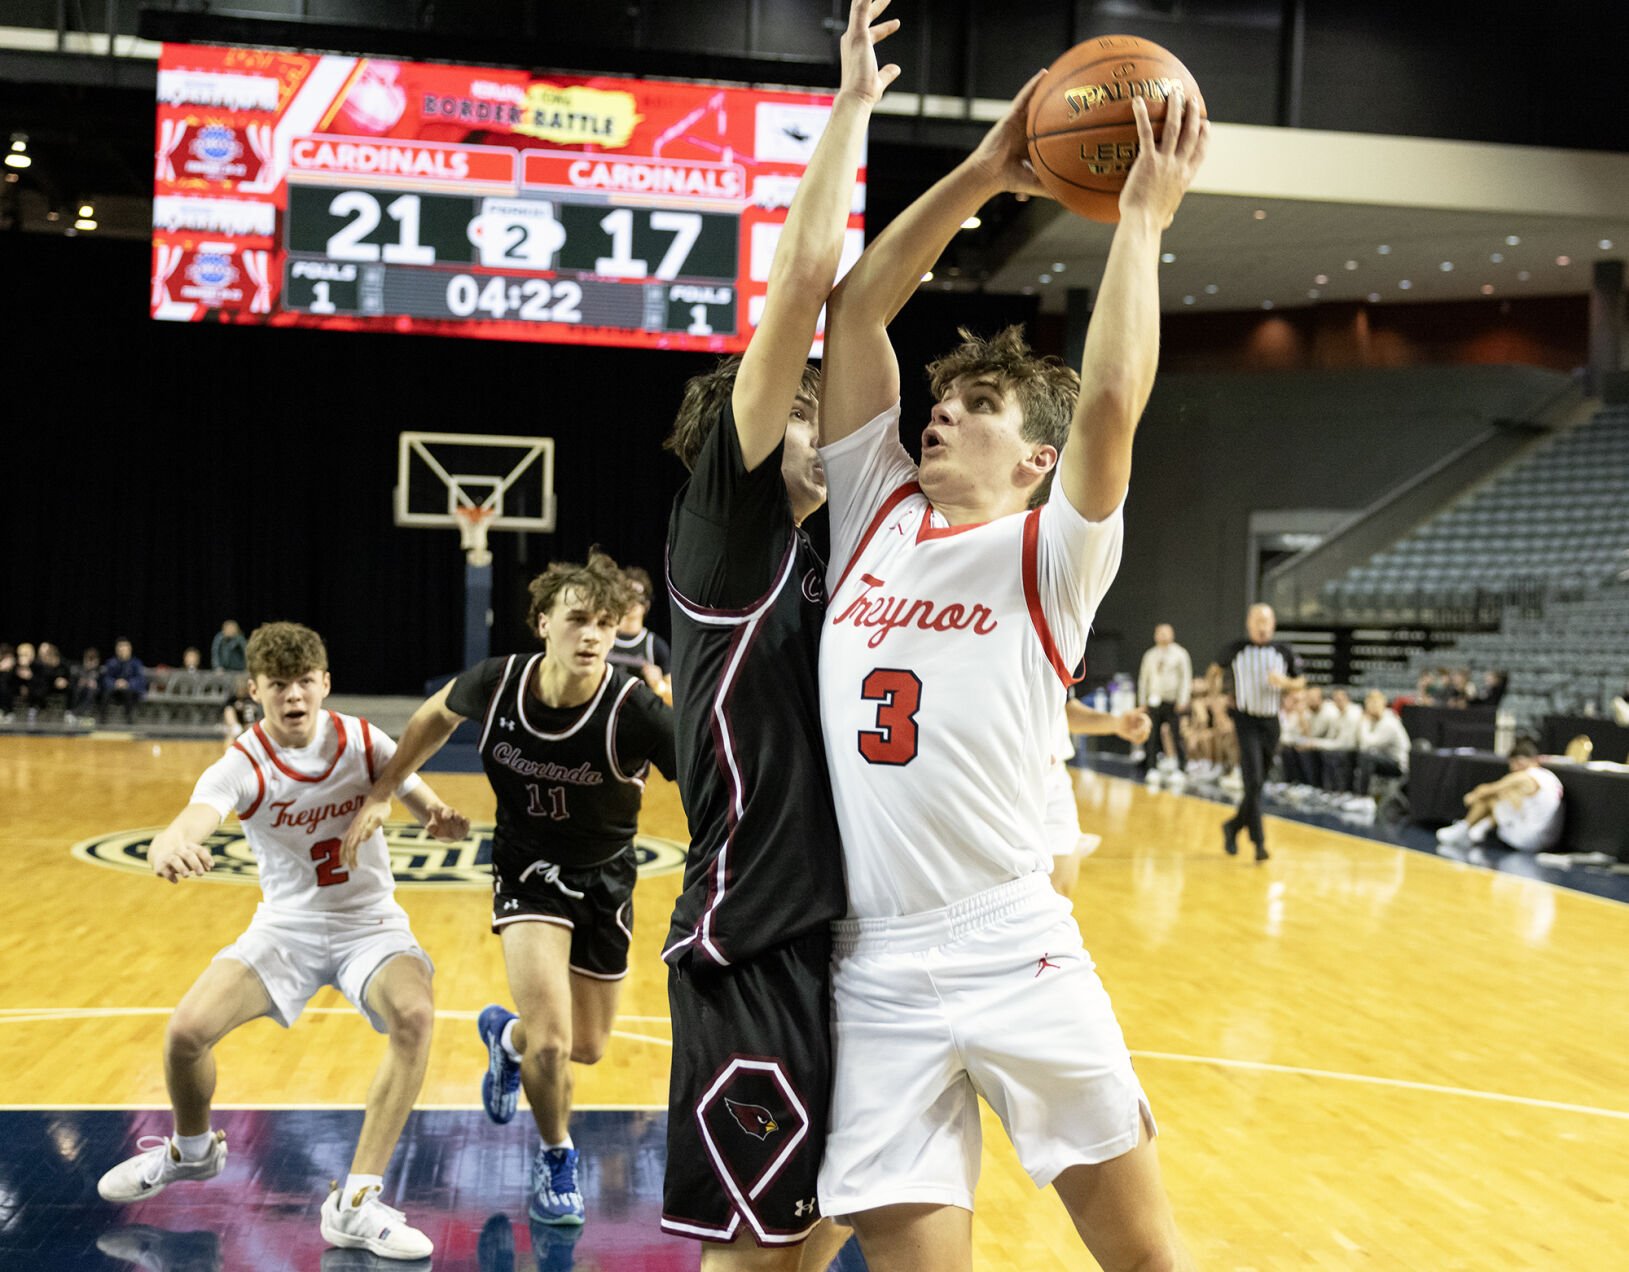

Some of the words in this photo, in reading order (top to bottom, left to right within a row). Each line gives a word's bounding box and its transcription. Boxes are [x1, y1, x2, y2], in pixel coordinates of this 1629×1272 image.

[424, 96, 522, 124] BORDER
[534, 109, 614, 136] BATTLE
[294, 141, 470, 179] CARDINALS
[1080, 143, 1140, 161] LEG
[568, 161, 740, 196] CARDINALS
[327, 191, 436, 265] 21
[505, 225, 528, 259] 2
[595, 209, 703, 281] 17
[309, 281, 337, 314] 1
[446, 274, 582, 323] 04:22
[687, 304, 713, 336] 1
[833, 573, 998, 649] Treynor
[858, 667, 923, 767] 3
[493, 741, 604, 786] Clarinda
[526, 784, 570, 821] 11
[310, 837, 349, 887] 2
